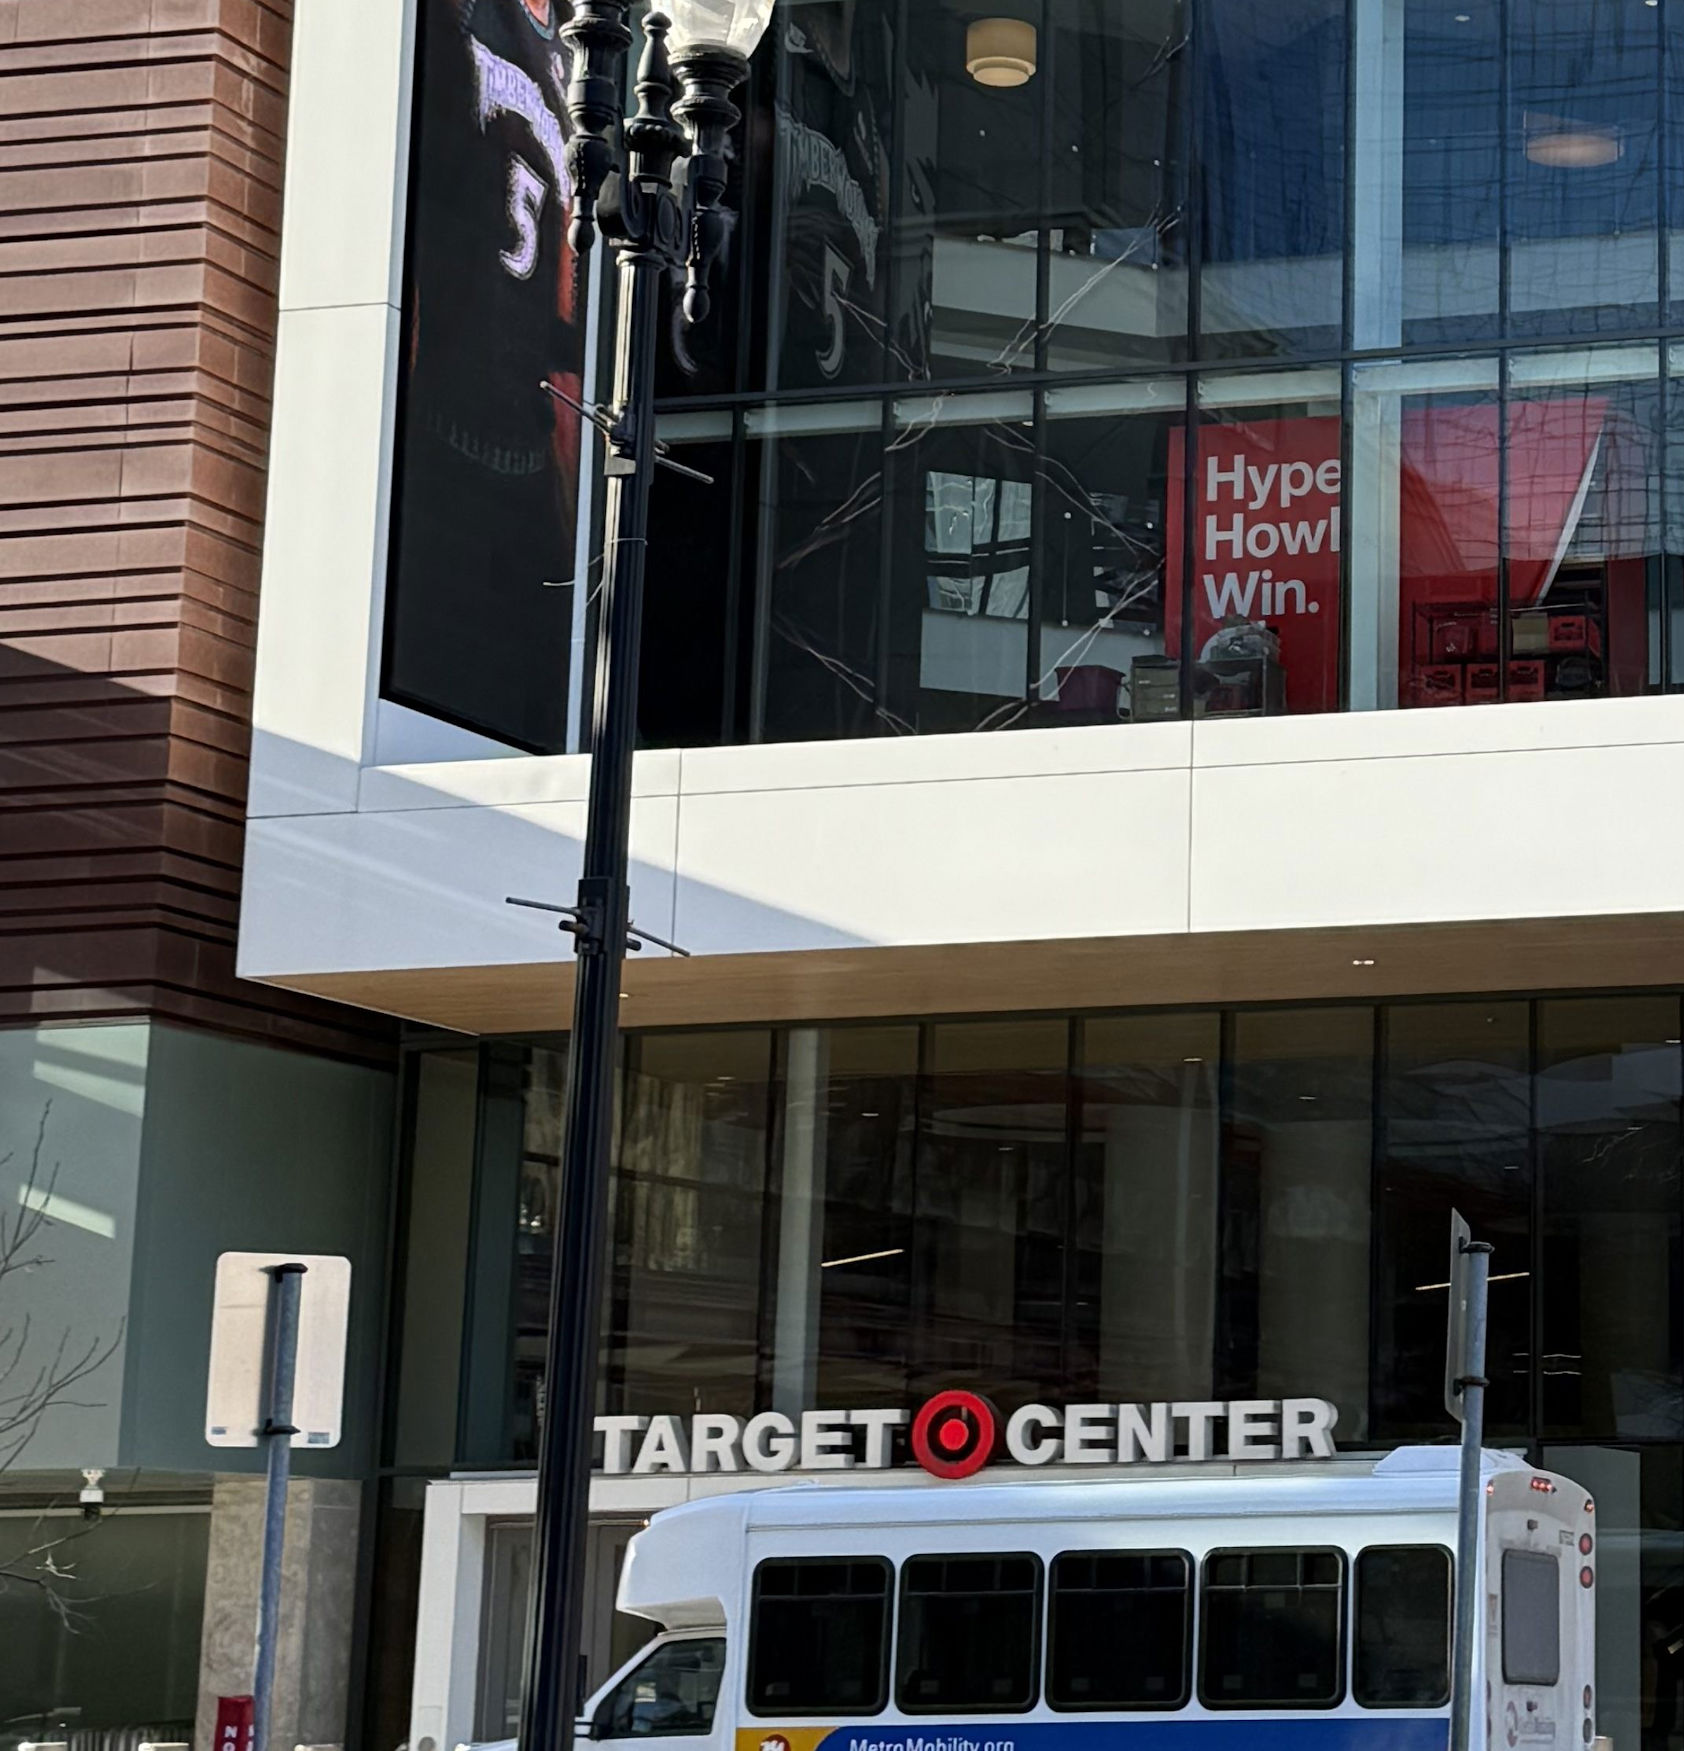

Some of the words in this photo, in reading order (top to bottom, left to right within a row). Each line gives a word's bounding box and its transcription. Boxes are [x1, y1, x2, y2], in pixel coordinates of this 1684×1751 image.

[500, 152, 549, 280] 5
[1206, 453, 1342, 510] Hype
[1205, 506, 1341, 561] Howl
[1203, 570, 1320, 619] Win.
[593, 1408, 911, 1475] TARGET
[1005, 1397, 1338, 1466] CENTER
[849, 1737, 1015, 1751] MetroMobilityorg
